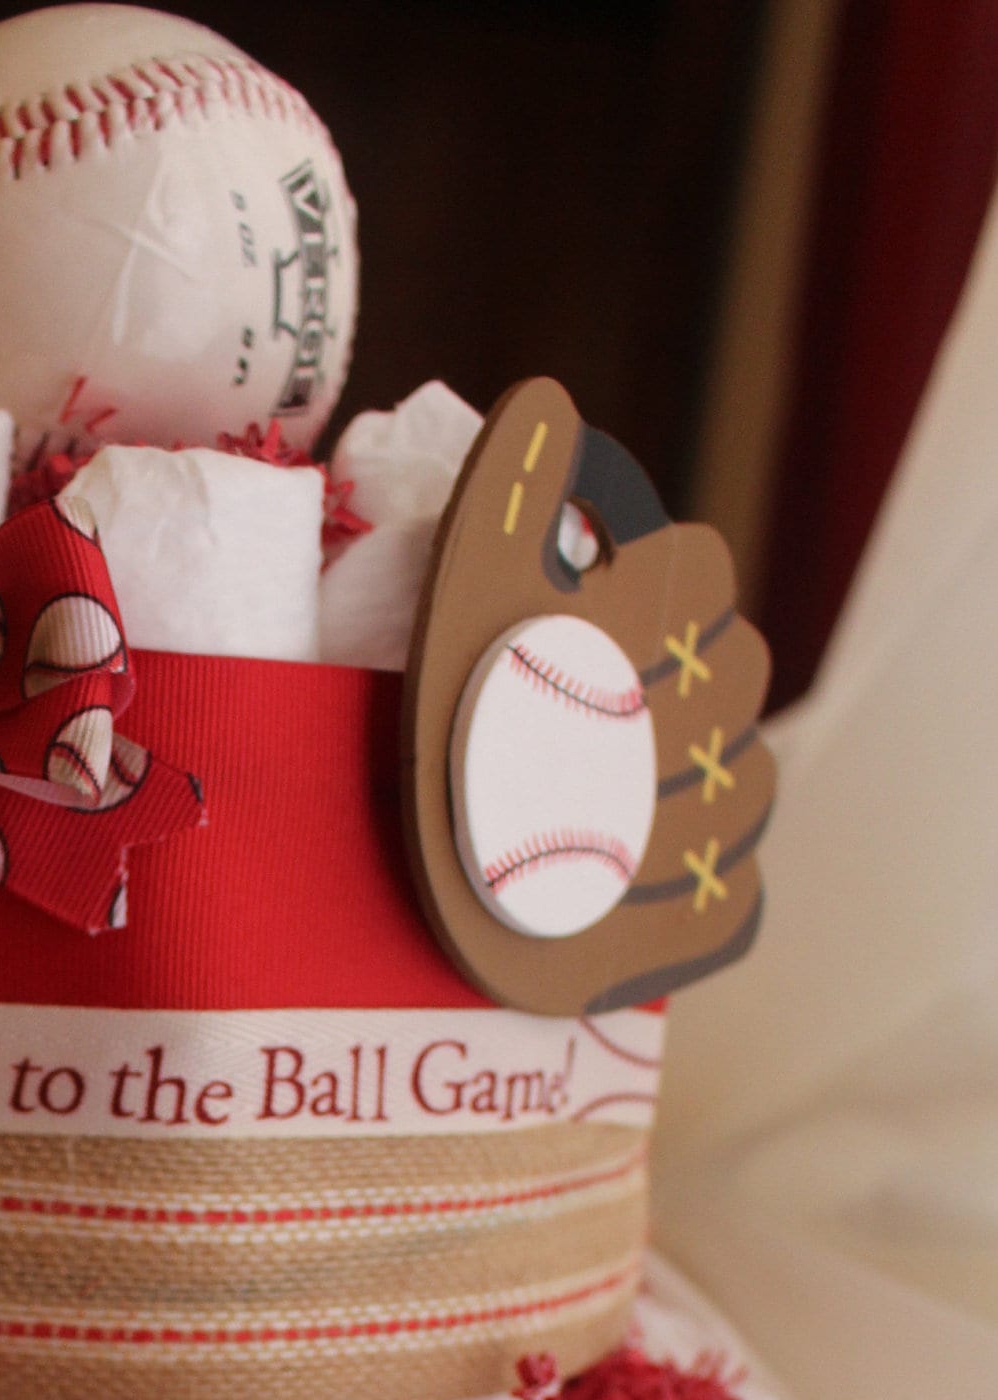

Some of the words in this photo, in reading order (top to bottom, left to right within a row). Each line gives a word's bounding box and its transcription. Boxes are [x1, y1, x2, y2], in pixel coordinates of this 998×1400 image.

[8, 1055, 85, 1115] to
[108, 1045, 233, 1125] the
[255, 1044, 389, 1123] Ball
